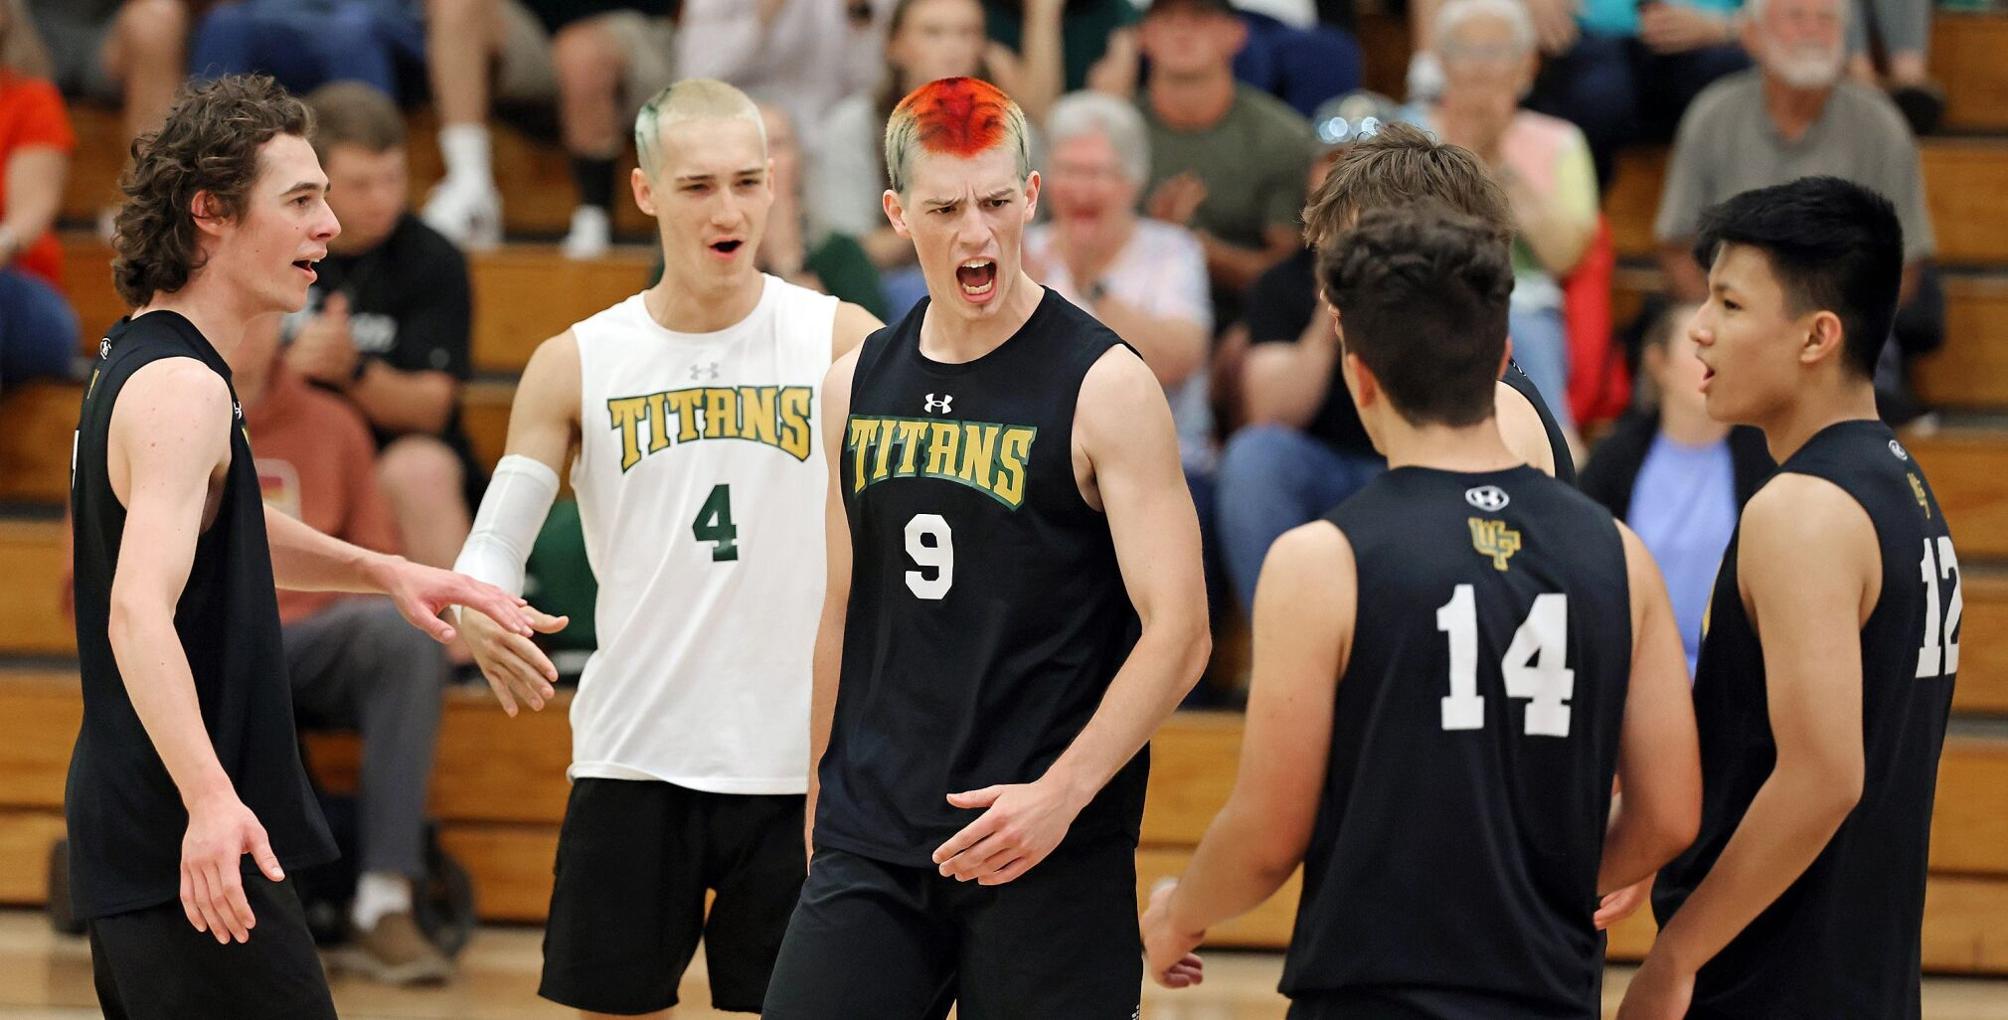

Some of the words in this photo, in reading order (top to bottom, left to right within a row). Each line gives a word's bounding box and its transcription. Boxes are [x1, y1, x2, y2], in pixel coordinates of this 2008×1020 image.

[607, 385, 813, 474] TITANS
[848, 414, 1037, 512] TITANS
[692, 483, 738, 562] 4
[904, 513, 954, 600] 9
[1915, 536, 1963, 679] 12
[1436, 584, 1574, 737] 14
